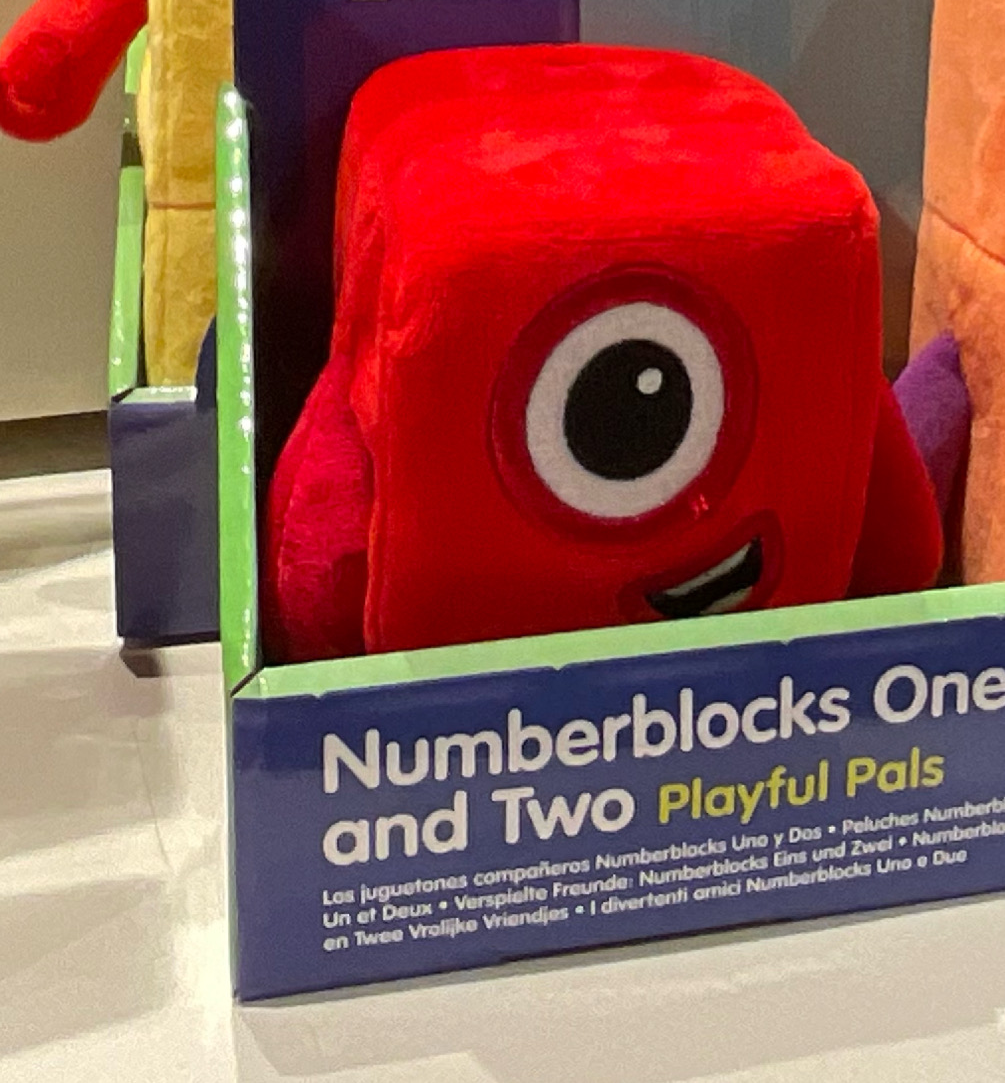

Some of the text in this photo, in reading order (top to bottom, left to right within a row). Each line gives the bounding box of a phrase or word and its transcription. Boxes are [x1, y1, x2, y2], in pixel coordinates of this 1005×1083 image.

[323, 676, 851, 794] Numberblocks
[322, 747, 945, 866] and Two Playful Pals
[360, 873, 467, 904] juguetones
[473, 858, 590, 887] compañeros
[595, 837, 726, 870] Numberblocks
[731, 833, 767, 853] Uno
[773, 834, 783, 848] y
[789, 825, 822, 844] Dos
[843, 812, 919, 835] Peluches
[323, 911, 351, 929] Un
[356, 907, 377, 925] et
[383, 902, 432, 921] Deux
[454, 884, 547, 911] Verspielte
[640, 854, 768, 887] Numberblocks
[773, 848, 807, 867] Eins
[812, 841, 845, 862] und
[851, 835, 893, 856] Zwei
[323, 935, 349, 952] en
[354, 928, 404, 947] Twee
[408, 918, 478, 939] Vrolijke
[483, 906, 569, 930] Vriendjes
[601, 890, 687, 915] divertenti
[693, 881, 742, 901] amici
[746, 861, 871, 894] Numberblocks
[876, 856, 912, 875] Uno
[917, 856, 928, 868] e
[932, 848, 968, 867] Due
